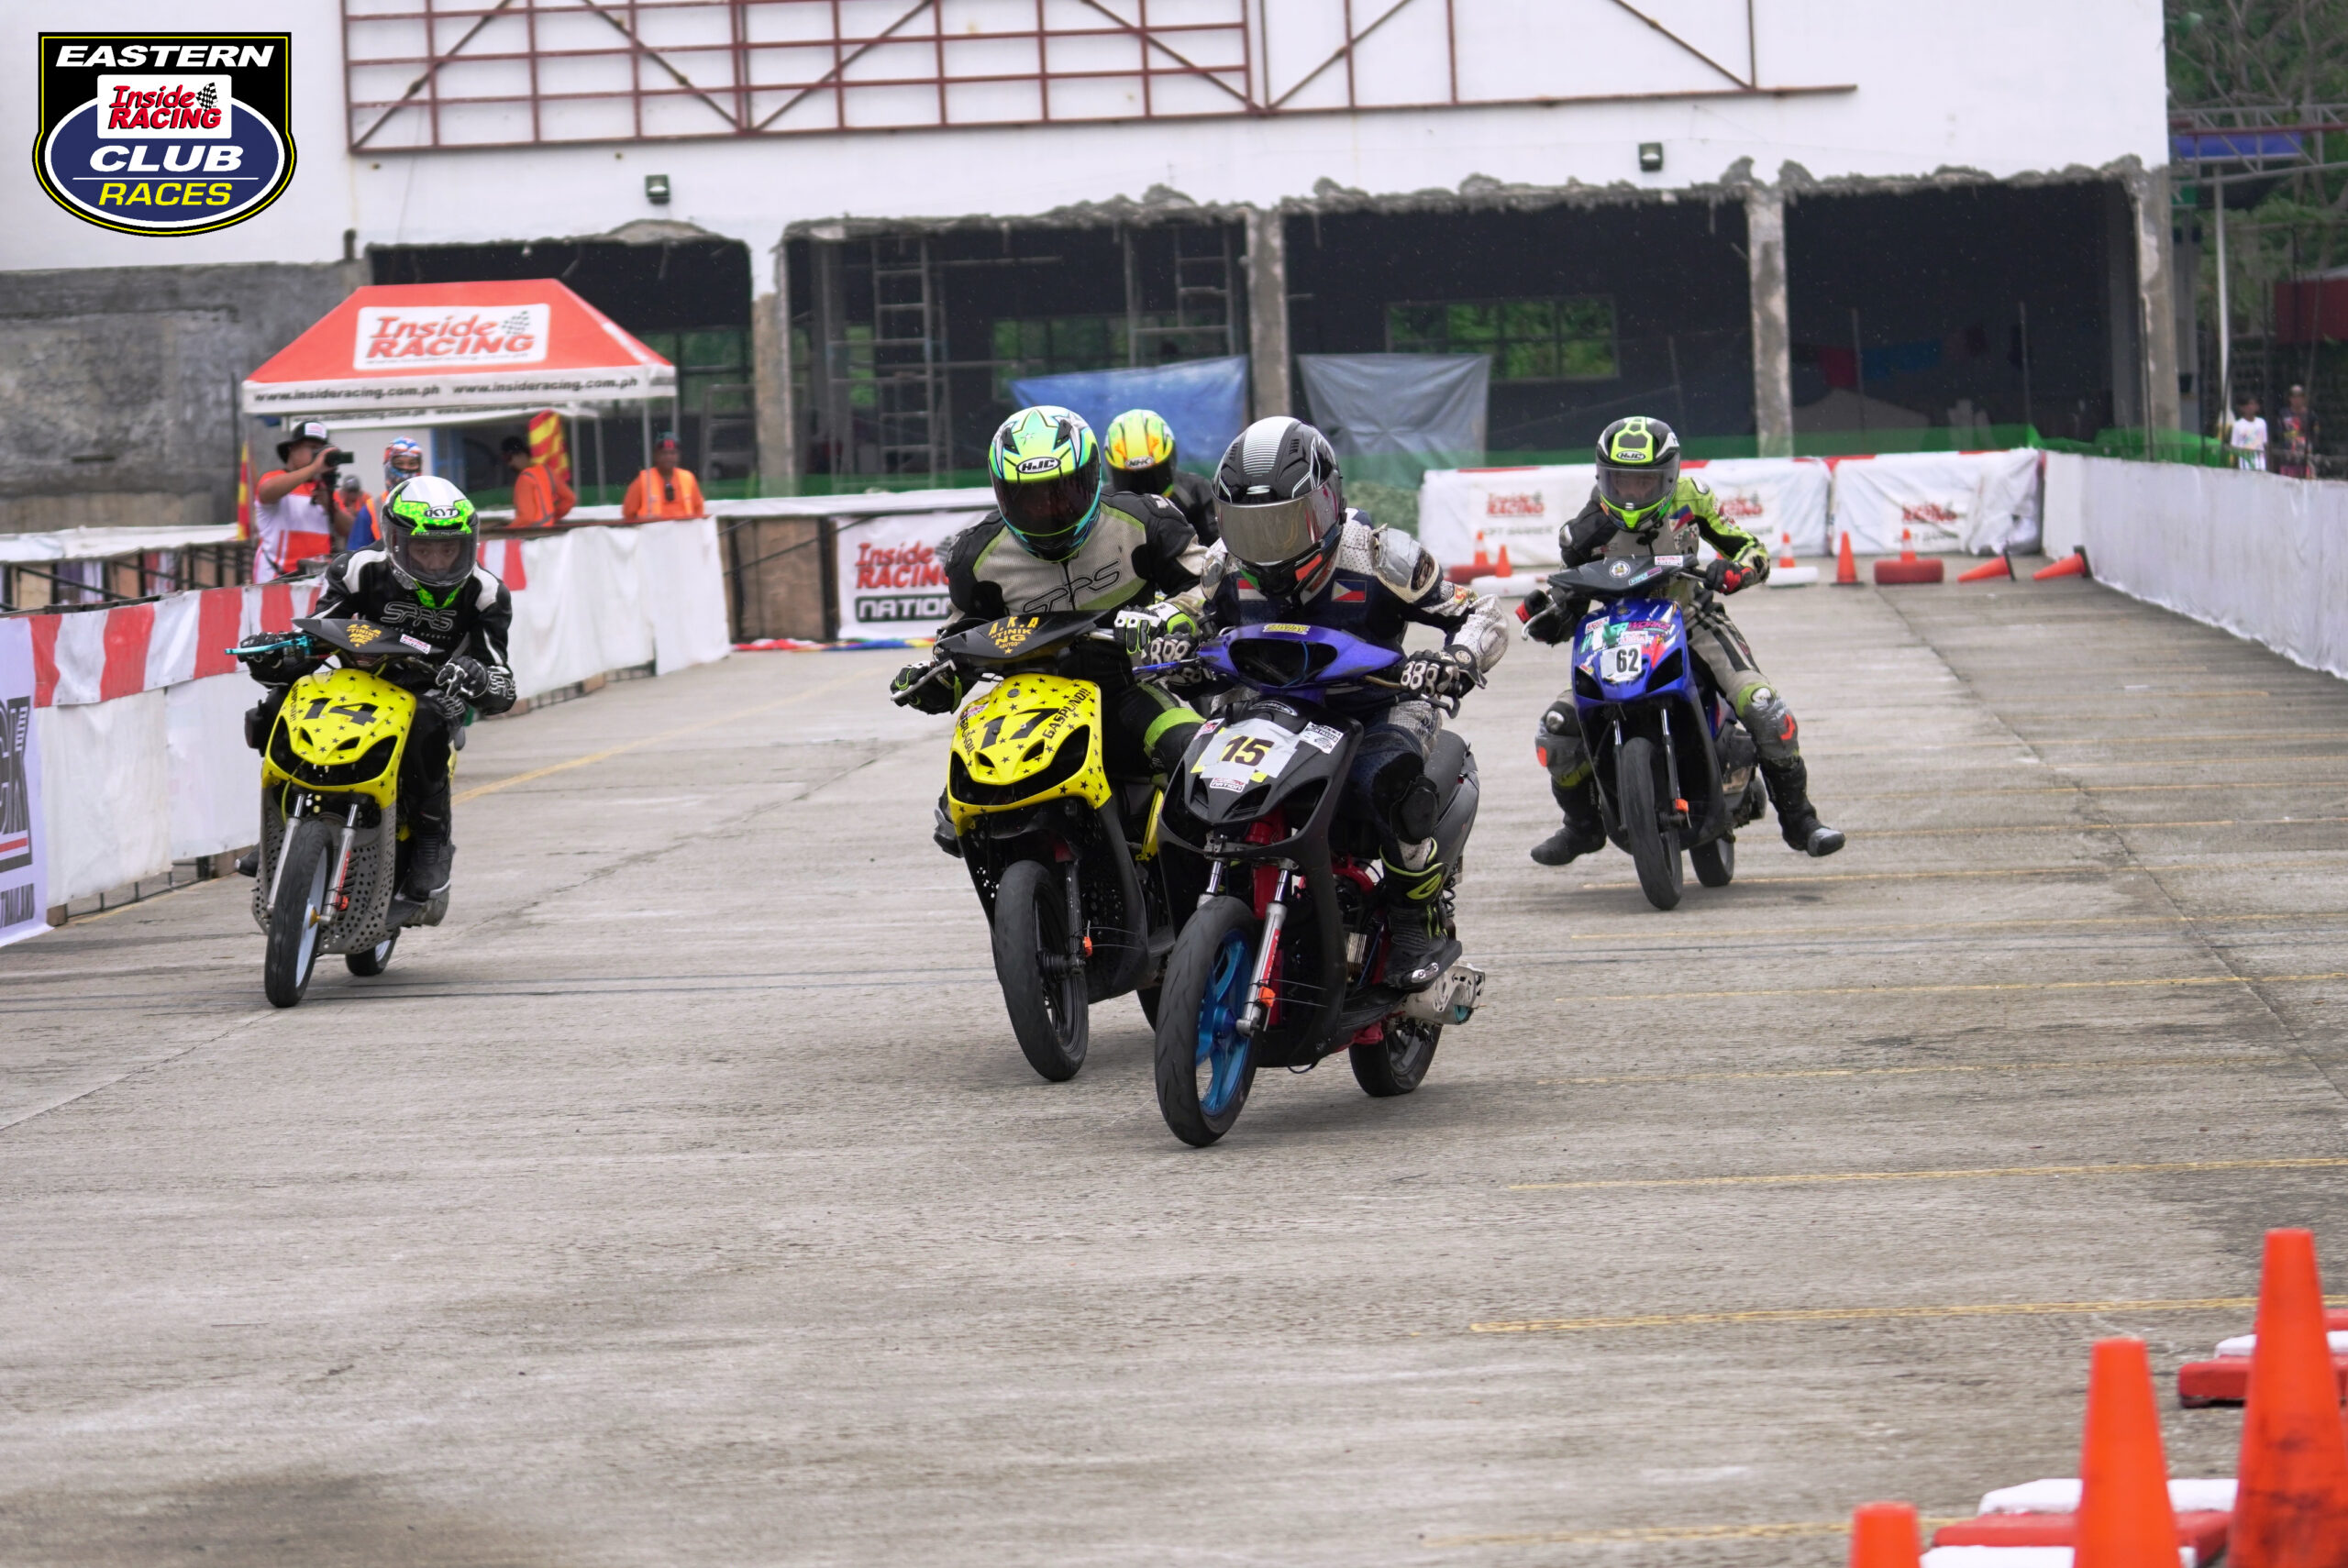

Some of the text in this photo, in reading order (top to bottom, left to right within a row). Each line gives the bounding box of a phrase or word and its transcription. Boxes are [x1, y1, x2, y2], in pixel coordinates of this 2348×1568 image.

[371, 315, 499, 338] Inside
[366, 334, 535, 359] RACING
[253, 377, 638, 402] www.insideracing.com.ph www.insideracing.com.ph
[1022, 460, 1055, 472] HJC
[1617, 451, 1642, 459] HJC
[428, 508, 456, 517] KYT
[855, 542, 934, 567] Inside
[995, 634, 1026, 646] NG
[1616, 648, 1639, 673] 62
[303, 697, 379, 726] 14
[980, 708, 1060, 750] 17
[1222, 735, 1275, 767] 15
